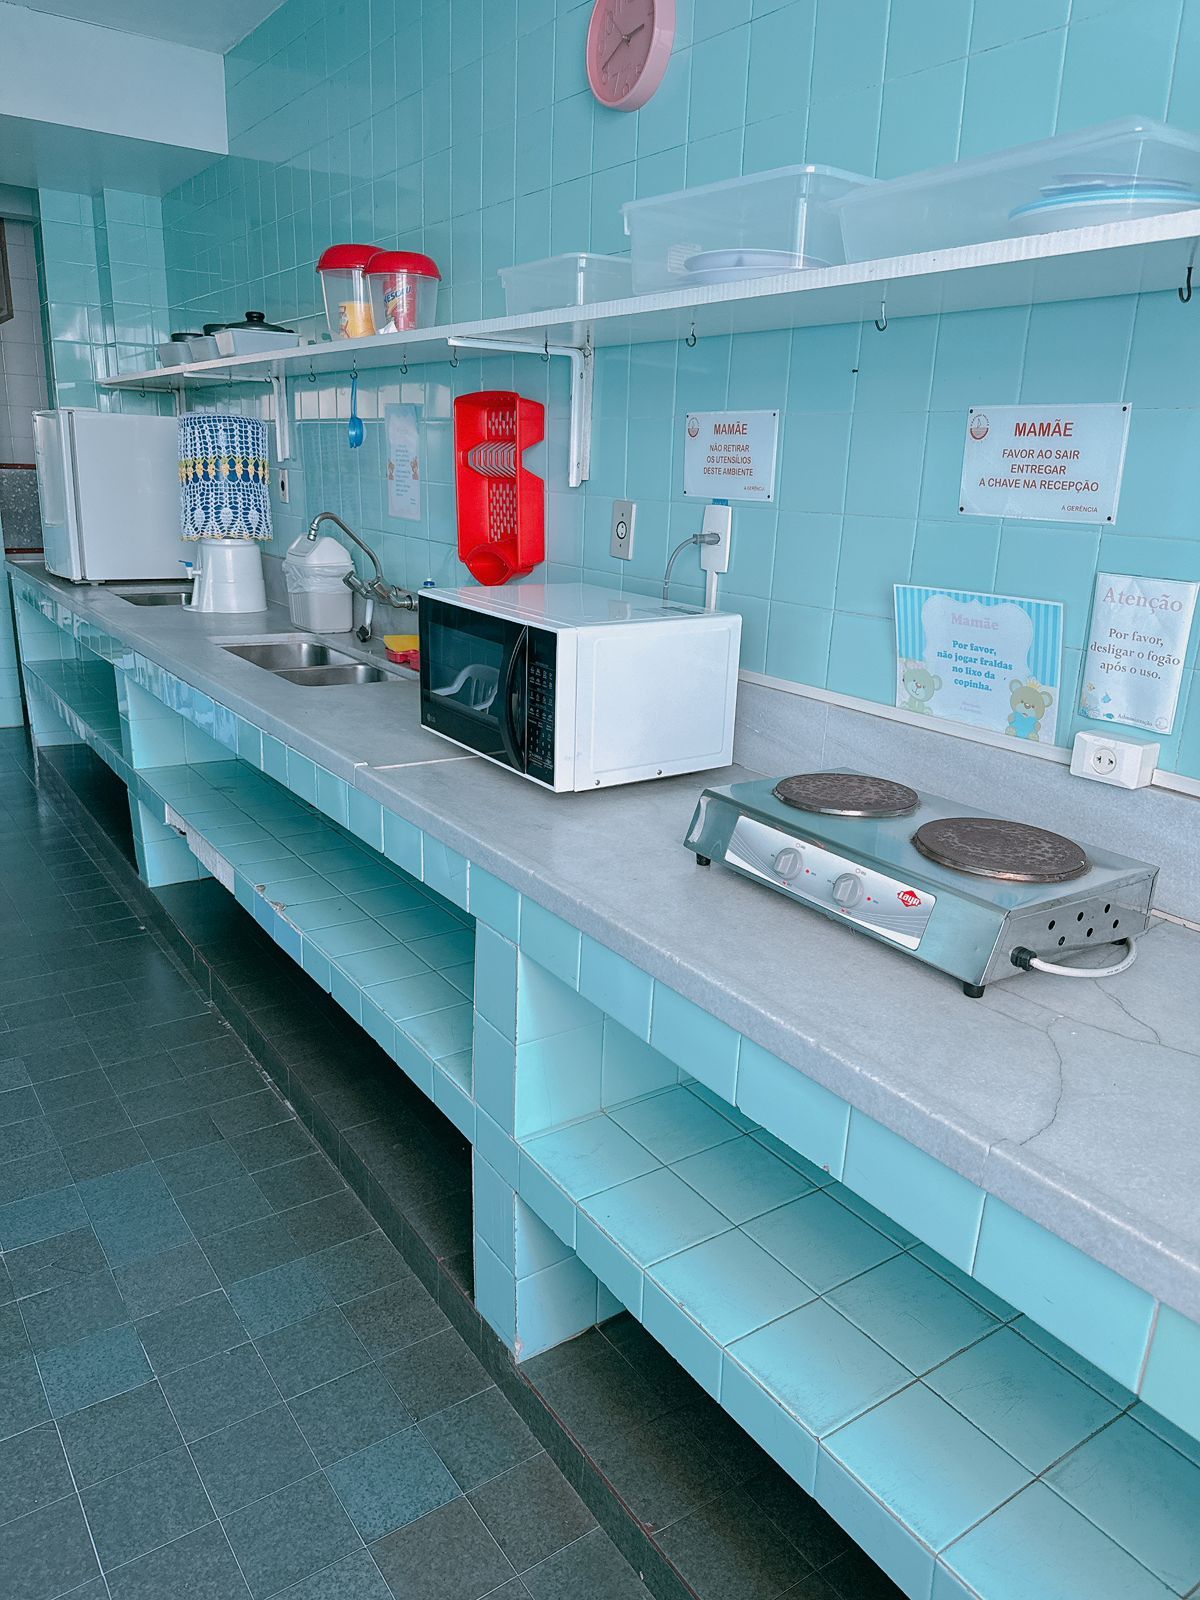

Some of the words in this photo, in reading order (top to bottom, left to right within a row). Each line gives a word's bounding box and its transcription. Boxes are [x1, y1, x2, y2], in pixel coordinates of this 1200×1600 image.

[713, 420, 748, 435] MAMÃE
[1014, 418, 1074, 437] MAMÃE
[709, 442, 723, 452] NÃO
[723, 444, 750, 453] RETIRAR
[1002, 448, 1034, 459] FAVOR
[1036, 449, 1053, 459] AO
[1054, 450, 1080, 460] SAIR
[706, 455, 715, 464] OS
[716, 454, 752, 465] UTENSÍLIOS
[703, 466, 721, 475] DESTE
[722, 467, 753, 476] AMBIENTE
[1010, 463, 1067, 475] ENTREGAR
[978, 478, 986, 487] A
[987, 478, 1020, 488] CHAVE
[1022, 479, 1037, 489] NA
[1039, 480, 1099, 493] RECEPÇÃO
[1066, 504, 1098, 513] GERÊNCIA
[1102, 586, 1183, 614] Atenção
[951, 613, 999, 630] Mamãe
[1108, 628, 1129, 640] Por
[1131, 630, 1164, 647] favor,
[952, 639, 968, 650] Por
[969, 641, 997, 656] favor,
[1090, 641, 1135, 660] desligar
[1137, 652, 1144, 660] o
[1147, 651, 1181, 668] fogão
[936, 649, 953, 660] não
[954, 652, 979, 666] jogar
[979, 657, 1013, 671] fraldas
[952, 665, 964, 674] no
[964, 666, 983, 678] lixo
[984, 669, 995, 680] da
[1099, 661, 1127, 674] após
[1129, 667, 1137, 675] o
[1139, 668, 1161, 680] uso.
[953, 678, 993, 692] copinha.
